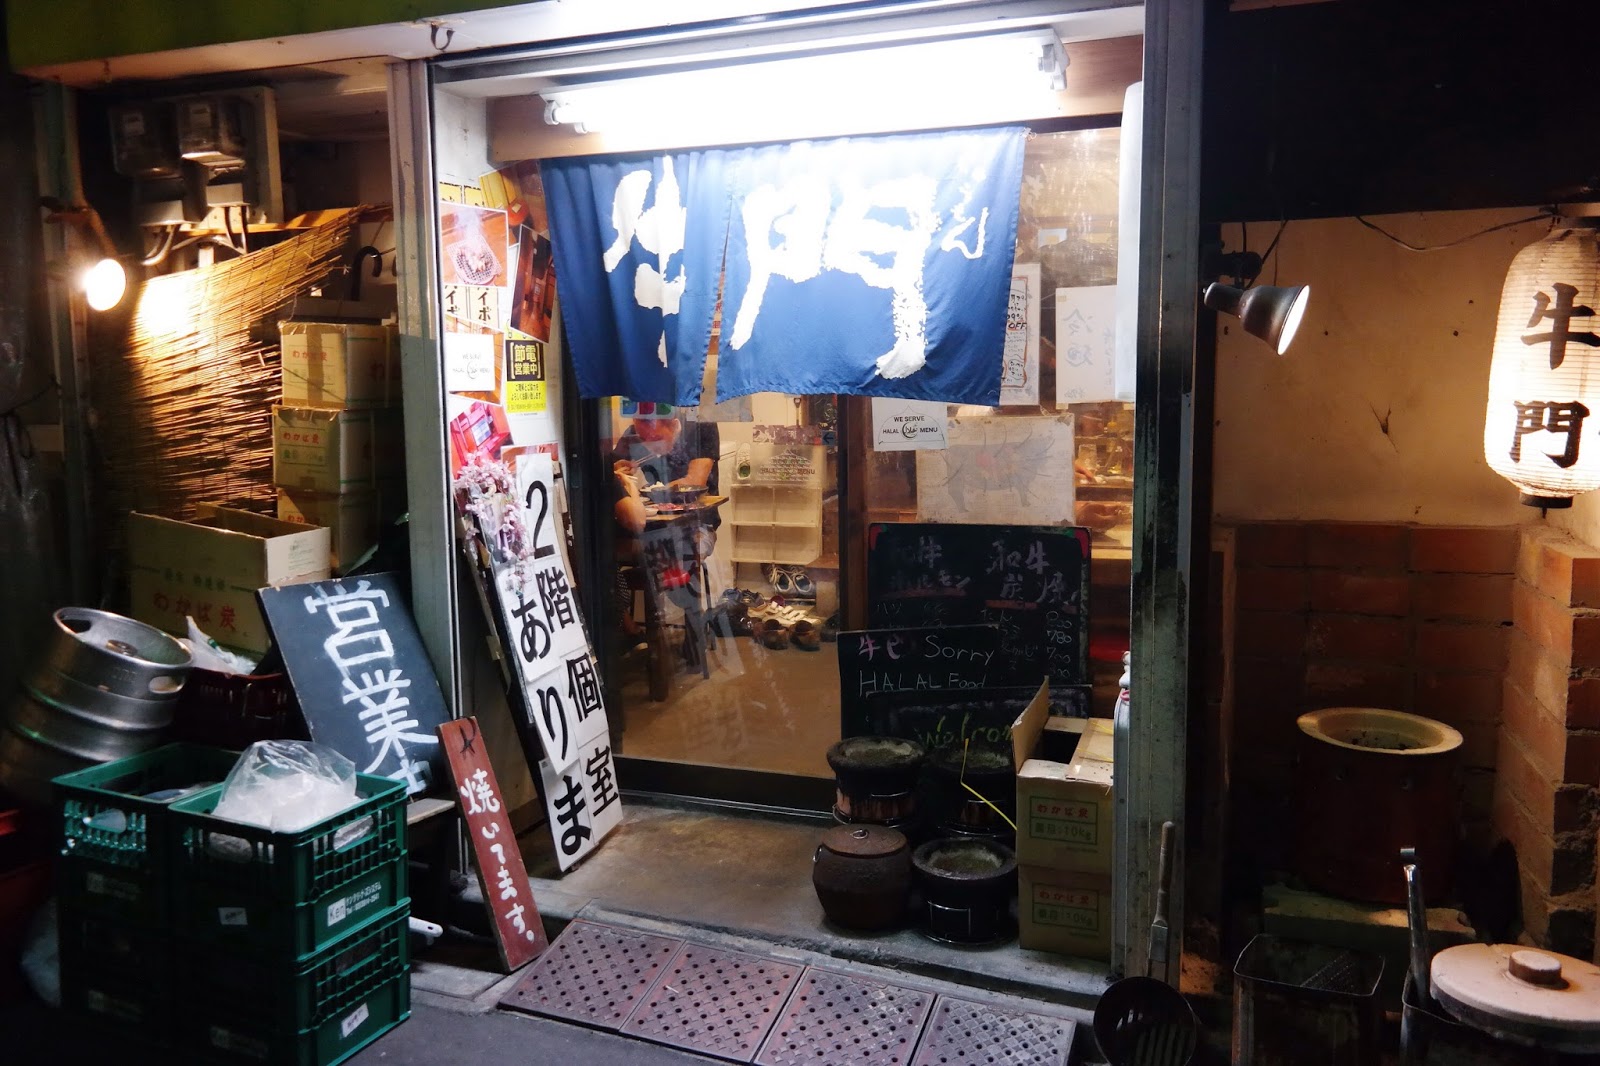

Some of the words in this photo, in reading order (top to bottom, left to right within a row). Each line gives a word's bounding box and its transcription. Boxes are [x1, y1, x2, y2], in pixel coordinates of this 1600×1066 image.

[1008, 321, 1027, 330] OFF
[514, 362, 538, 376] 営業中
[1508, 282, 1600, 469] 牛門
[904, 415, 925, 423] SERVE
[1046, 630, 1072, 644] 780
[924, 634, 995, 666] Sorry
[859, 669, 942, 698] HALAL
[948, 672, 987, 690] Food
